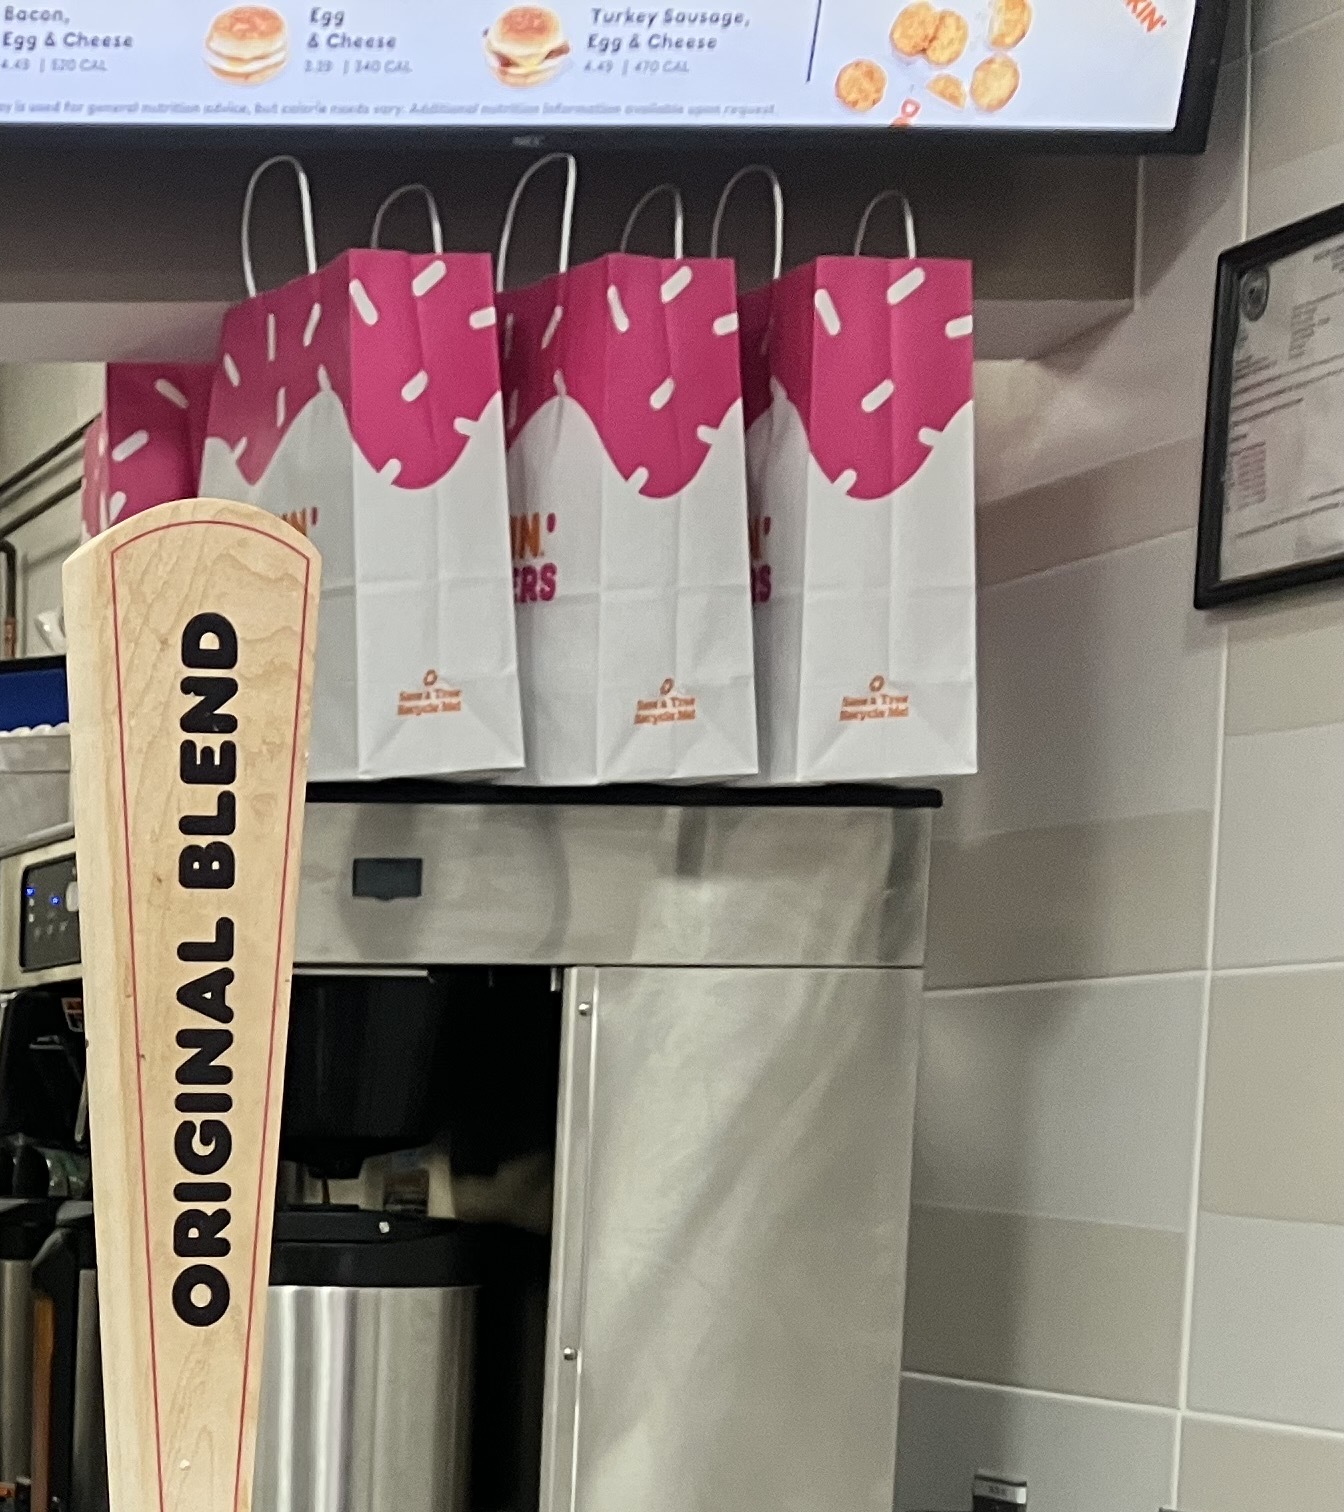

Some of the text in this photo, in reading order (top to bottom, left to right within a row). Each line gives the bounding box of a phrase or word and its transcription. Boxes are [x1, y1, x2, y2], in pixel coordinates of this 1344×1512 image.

[4, 6, 70, 25] Bacon,
[310, 7, 345, 27] Egg
[591, 8, 751, 28] Turkey Sausage,
[2, 32, 134, 50] Egg & Cheese
[307, 32, 398, 49] & Cheese
[587, 33, 718, 52] Egg & Cheese
[171, 611, 239, 1327] ORIGINAL BLEND
